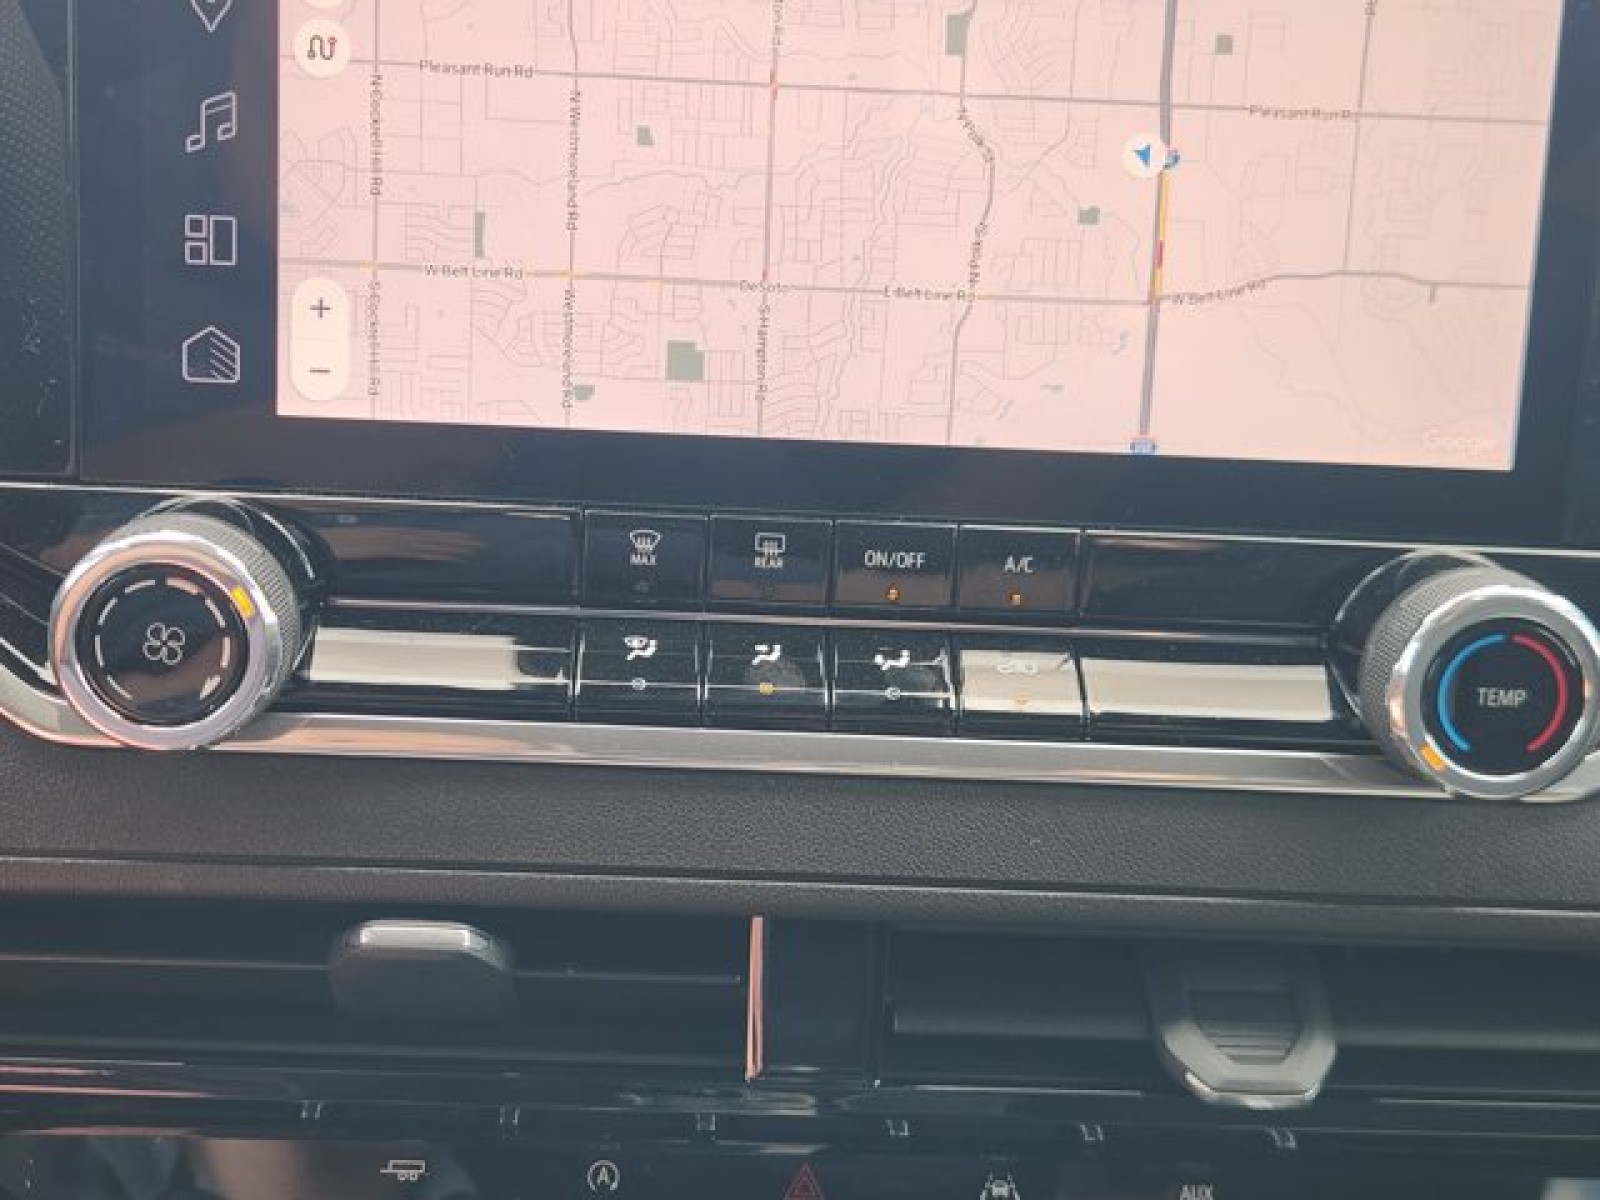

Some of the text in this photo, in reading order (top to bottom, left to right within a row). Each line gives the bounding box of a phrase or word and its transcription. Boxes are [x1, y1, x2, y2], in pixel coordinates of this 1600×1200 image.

[419, 59, 534, 79] Pleasant Run Rd
[567, 106, 581, 208] Westmoreland
[369, 177, 383, 196] Rd
[565, 211, 580, 231] Rd
[424, 264, 523, 280] W Belt Line Rd
[755, 317, 770, 381] Hampton
[367, 377, 381, 396] Rd
[629, 554, 658, 566] MAX
[754, 556, 785, 569] REAR
[864, 549, 927, 569] ON/OFF
[1003, 554, 1035, 573] A/C
[1476, 686, 1527, 708] TEMP
[1179, 1184, 1214, 1200] AUX
